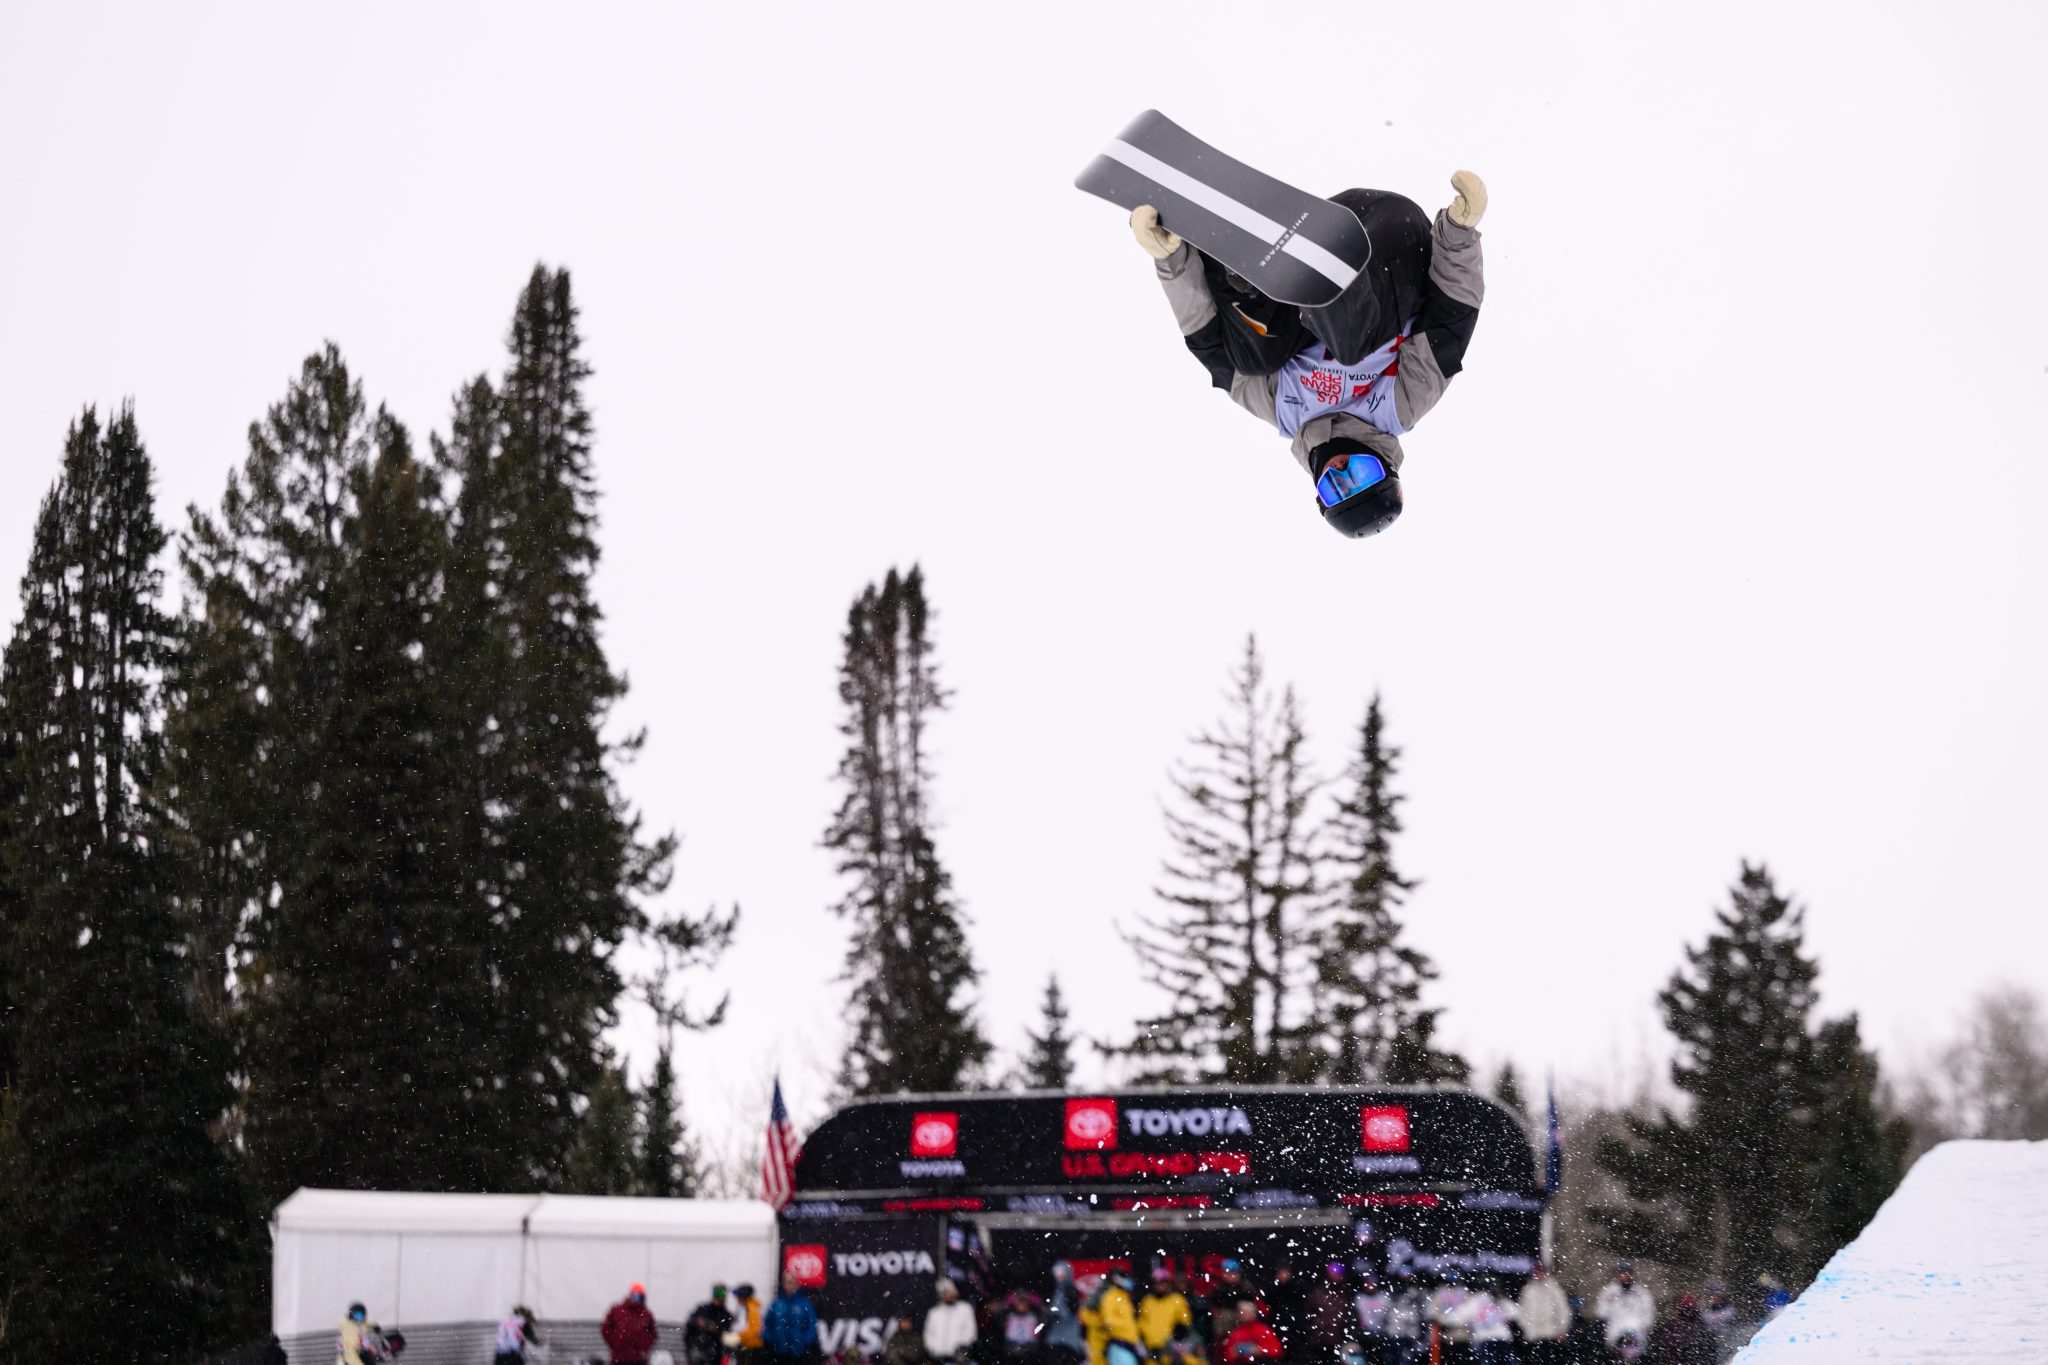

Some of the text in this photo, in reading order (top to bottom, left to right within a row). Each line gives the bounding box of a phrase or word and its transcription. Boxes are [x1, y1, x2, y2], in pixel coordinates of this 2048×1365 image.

[1259, 211, 1309, 268] WHITESPACE
[1300, 375, 1342, 394] GRAND
[1312, 369, 1342, 385] PRIX
[1316, 390, 1340, 406] U.S.
[1124, 1106, 1252, 1137] TOYOTA
[832, 1250, 936, 1277] TOYOTA
